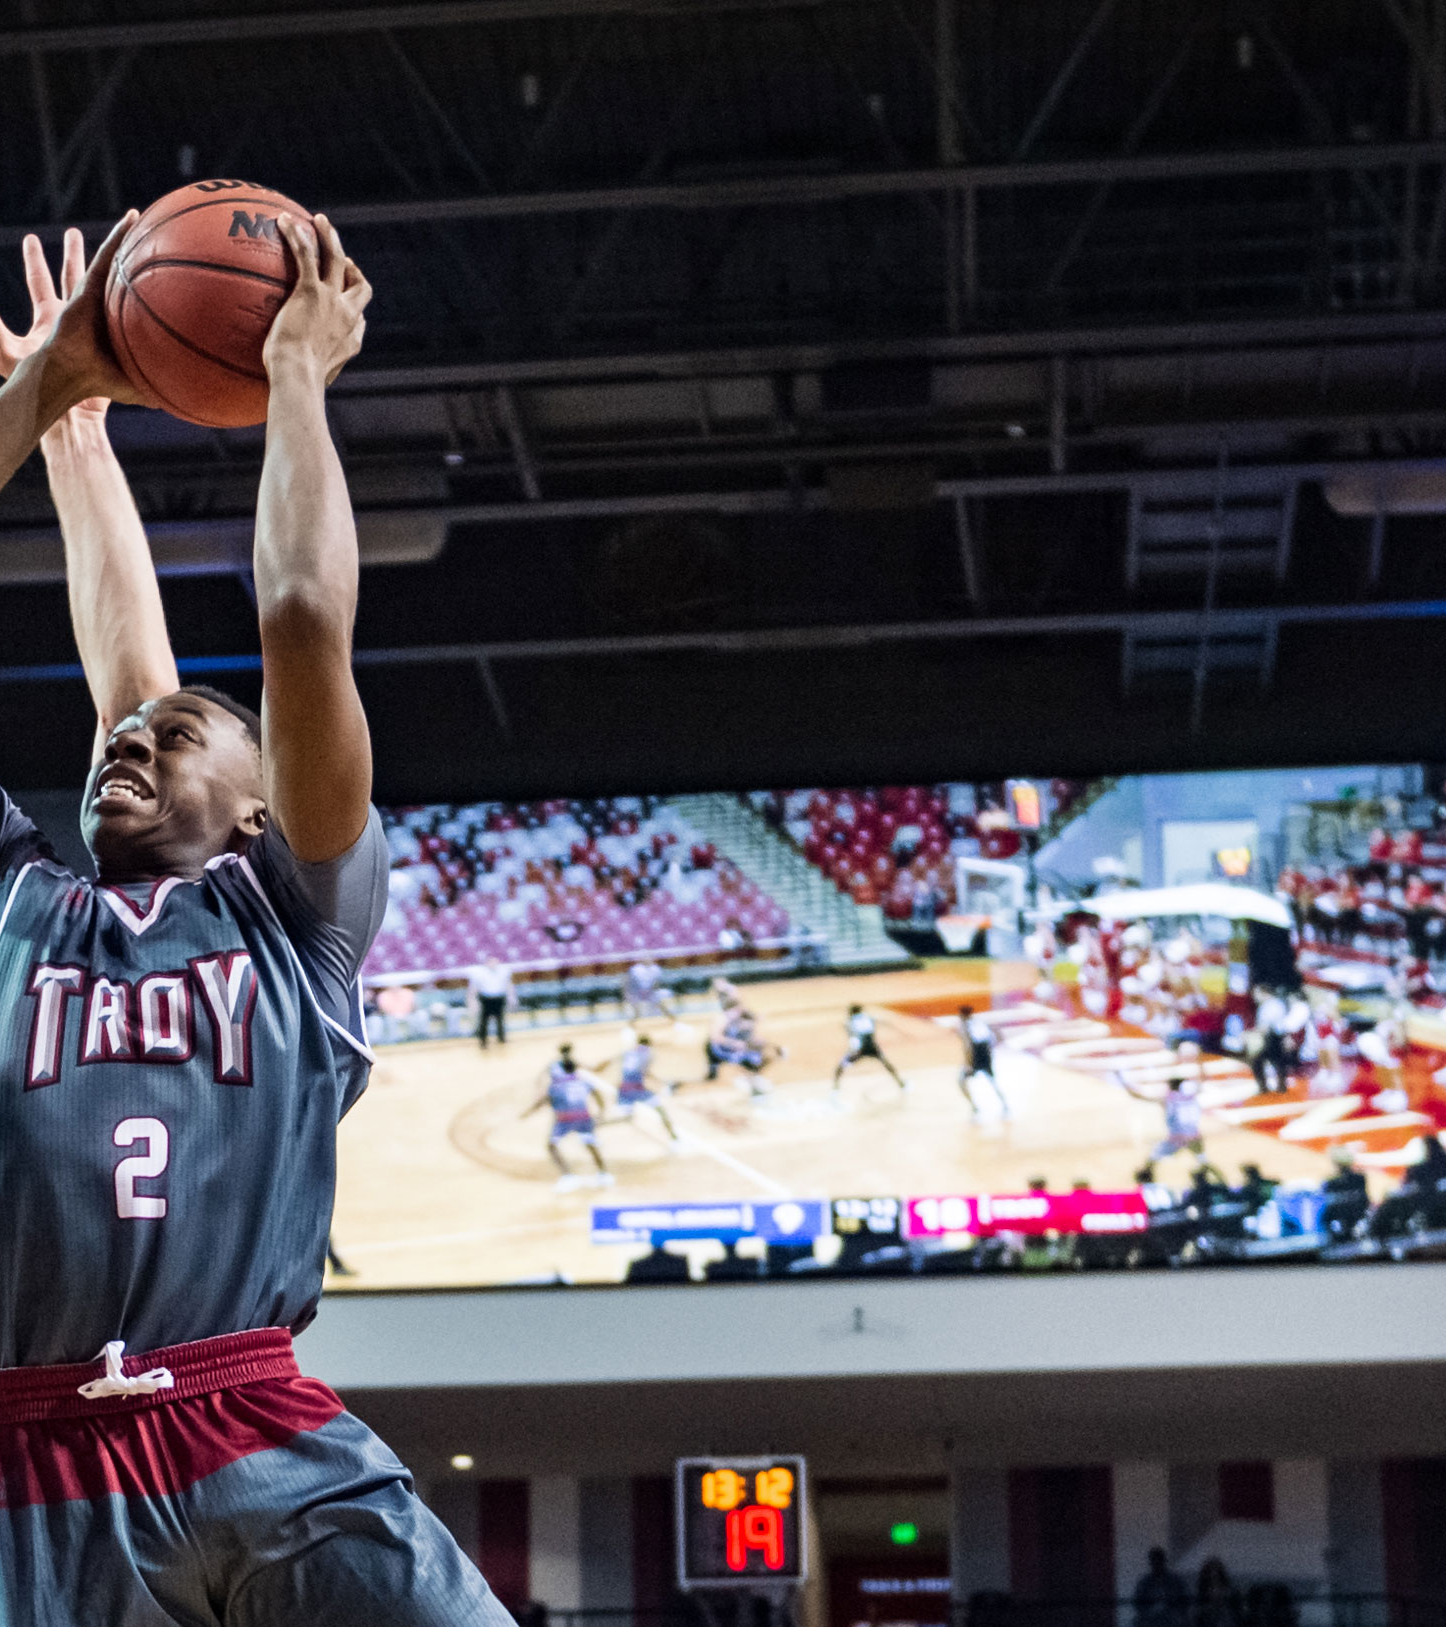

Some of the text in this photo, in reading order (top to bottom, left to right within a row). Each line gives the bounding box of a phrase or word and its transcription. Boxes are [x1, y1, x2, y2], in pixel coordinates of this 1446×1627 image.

[24, 949, 258, 1092] TROY
[113, 1116, 170, 1219] 2
[701, 1467, 794, 1511] 13:12
[726, 1504, 785, 1571] 19
